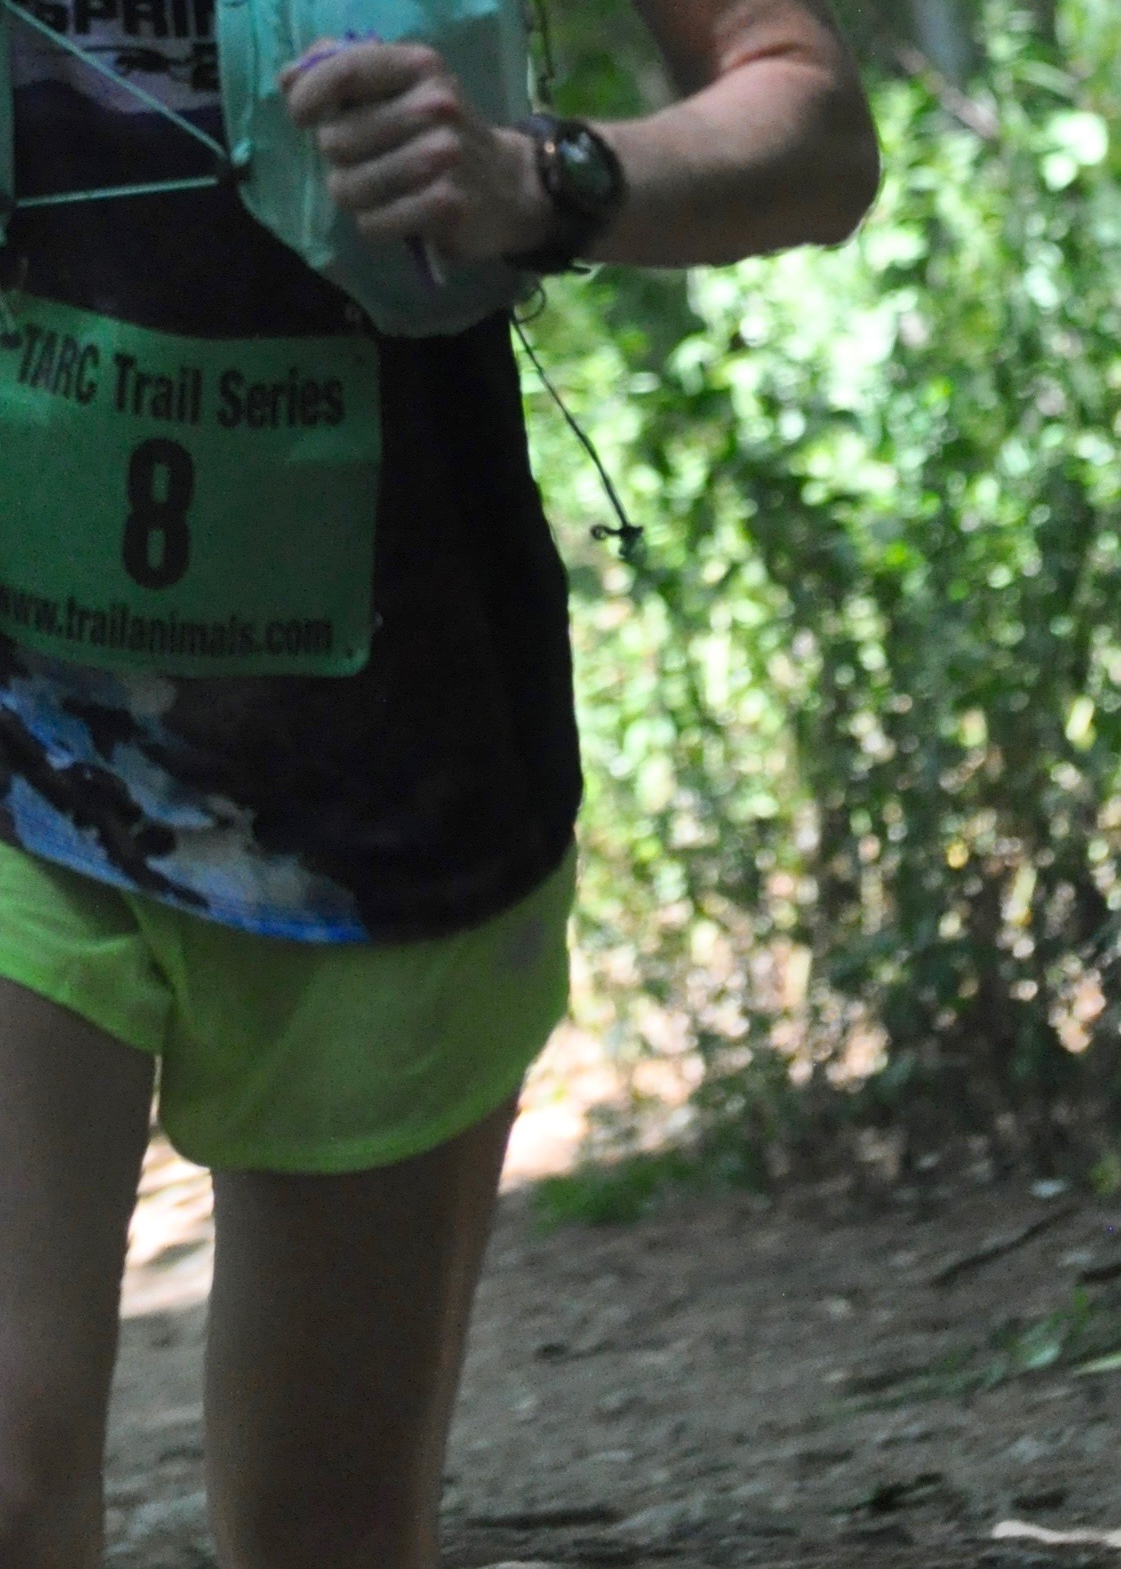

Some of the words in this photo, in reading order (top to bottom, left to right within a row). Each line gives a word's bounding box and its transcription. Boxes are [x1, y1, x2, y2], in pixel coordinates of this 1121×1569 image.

[16, 323, 101, 406] TARC
[113, 351, 203, 427] Trail
[216, 367, 346, 429] Series
[122, 437, 195, 591] 8
